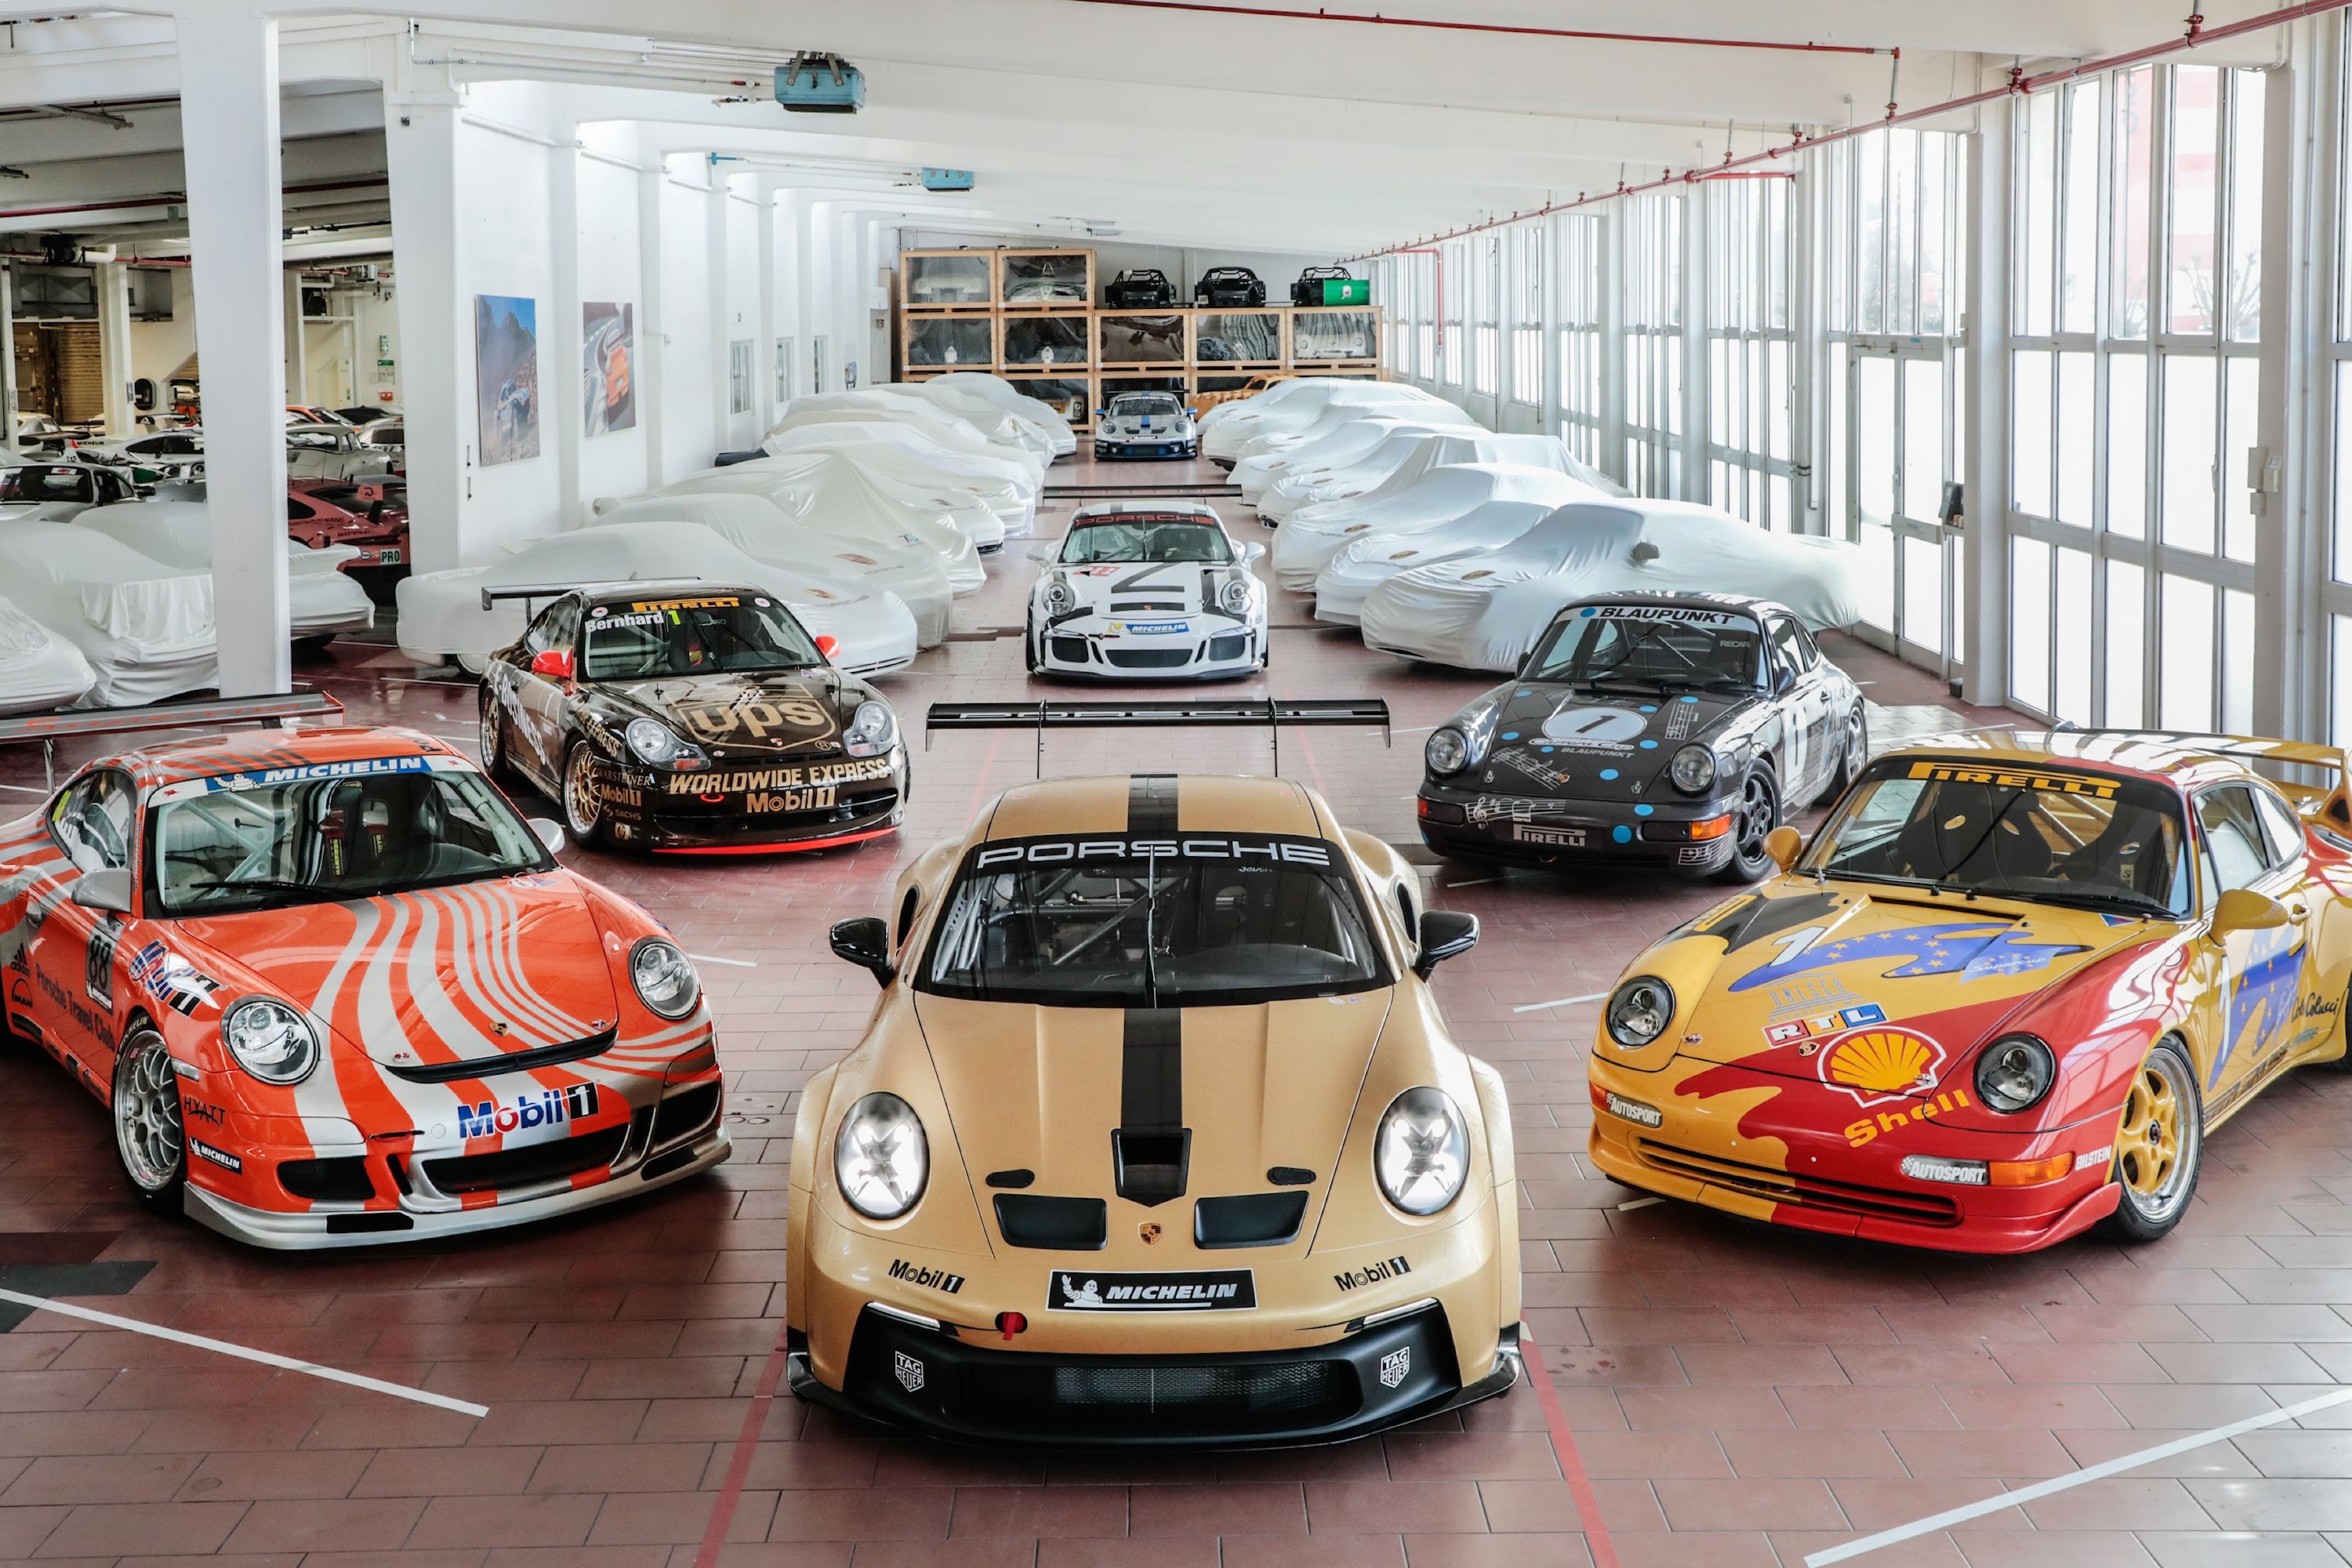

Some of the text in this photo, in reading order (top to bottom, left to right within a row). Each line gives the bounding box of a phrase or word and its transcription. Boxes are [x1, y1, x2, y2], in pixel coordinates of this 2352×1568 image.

[1076, 514, 1215, 528] PORSCHE
[381, 550, 400, 562] PRO
[631, 597, 740, 612] PIRELLI
[1599, 608, 1735, 624] BLAUPUNKT
[585, 610, 681, 633] Bernhard 1
[1131, 623, 1188, 633] MICHELIN
[689, 702, 826, 738] ups
[1575, 714, 1618, 734] 1
[1561, 747, 1635, 758] BLAUPUNKT
[264, 757, 422, 782] MICHELIN
[668, 759, 890, 794] WORLDWIDE EXPRESS
[1907, 761, 2122, 799] PIRELLI
[601, 783, 629, 804] Mobil
[746, 791, 812, 813] Mobil
[615, 808, 641, 820] SACHS
[1514, 824, 1586, 847] PIRELLI
[977, 840, 1330, 869] PORSCHE
[1770, 926, 1828, 967] 1
[89, 934, 112, 990] 88
[1969, 957, 2046, 973] Supercup
[13, 993, 33, 1008] MAN
[92, 987, 113, 1010] MICHELIN
[1769, 978, 1845, 1007] UNESCO
[36, 962, 67, 1011] Porsche
[95, 1013, 115, 1053] Club
[2218, 953, 2231, 1065] 1
[1769, 1009, 1878, 1042] RTL
[458, 1088, 564, 1139] Mobil
[1610, 1097, 1662, 1125] AUTOSPORT
[1844, 1089, 1970, 1148] Shell
[201, 1144, 240, 1170] MICHELIN
[2074, 1145, 2112, 1171] BILSTEIN
[1908, 1161, 1987, 1183] AUTOSPORT
[888, 1258, 944, 1289] Mobil
[1334, 1261, 1392, 1291] Mobil
[1106, 1283, 1237, 1300] MICHELIN
[897, 1355, 921, 1374] TAG
[1384, 1351, 1408, 1368] TAG
[896, 1368, 923, 1388] HEUER
[1382, 1364, 1409, 1382] HEUER
